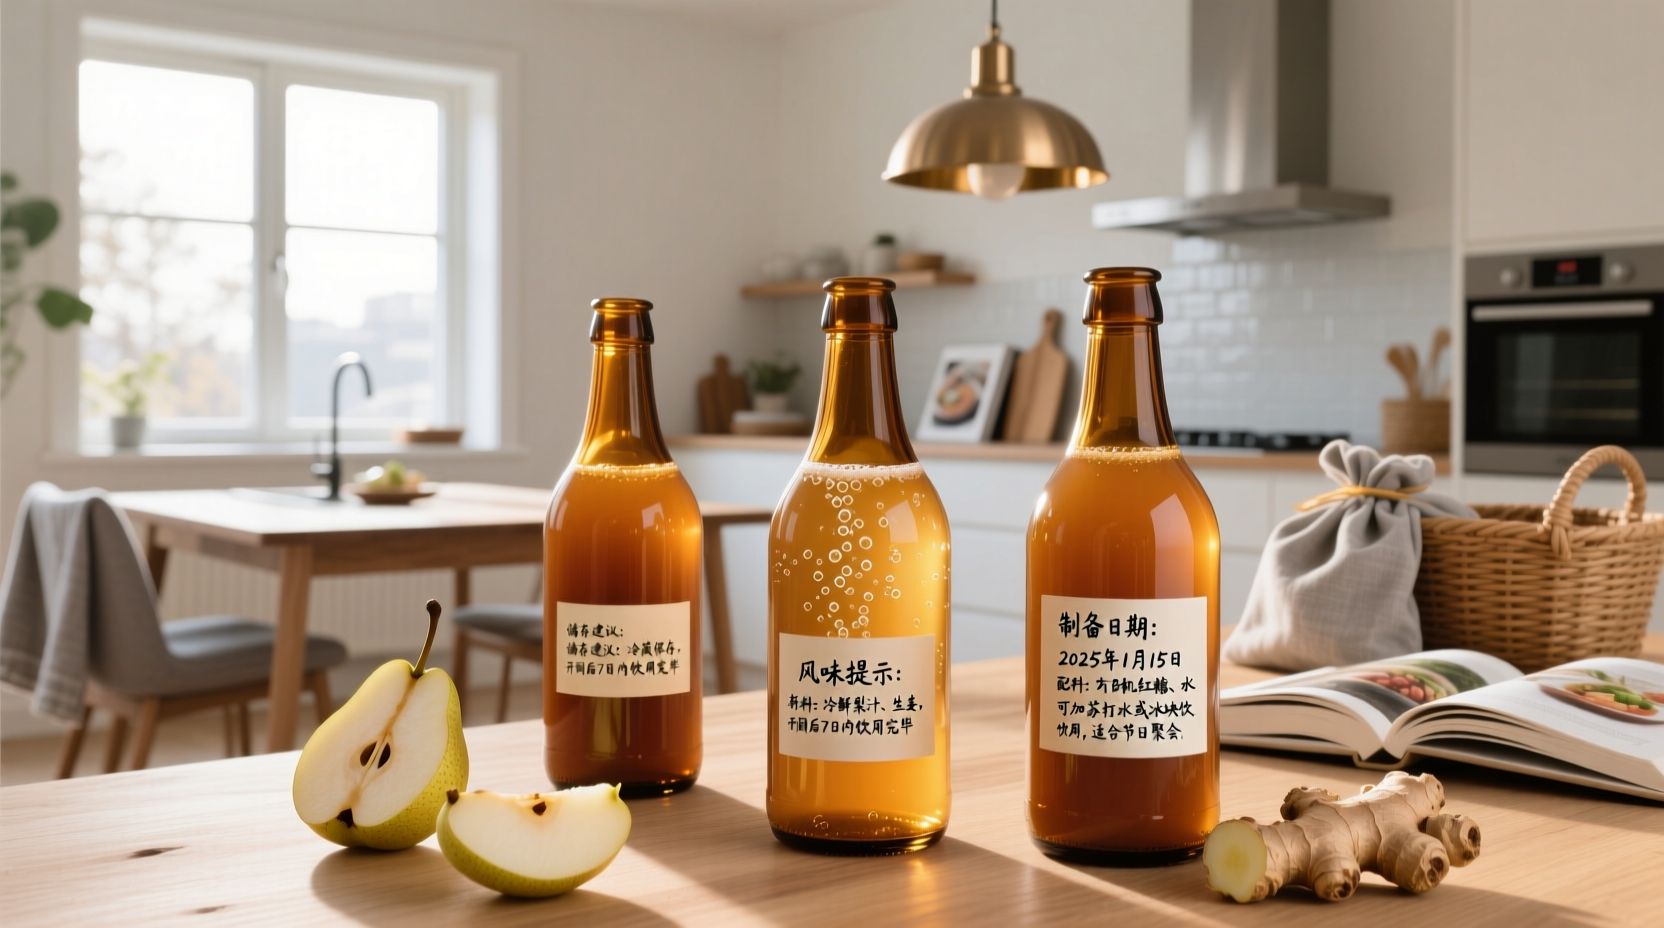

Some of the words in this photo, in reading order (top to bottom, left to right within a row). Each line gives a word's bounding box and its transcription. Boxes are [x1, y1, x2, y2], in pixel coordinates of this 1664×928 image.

[1058, 610, 1157, 641] 制备日期：
[798, 658, 901, 687] 风味提示：
[1058, 647, 1181, 671] 2025年1月15日
